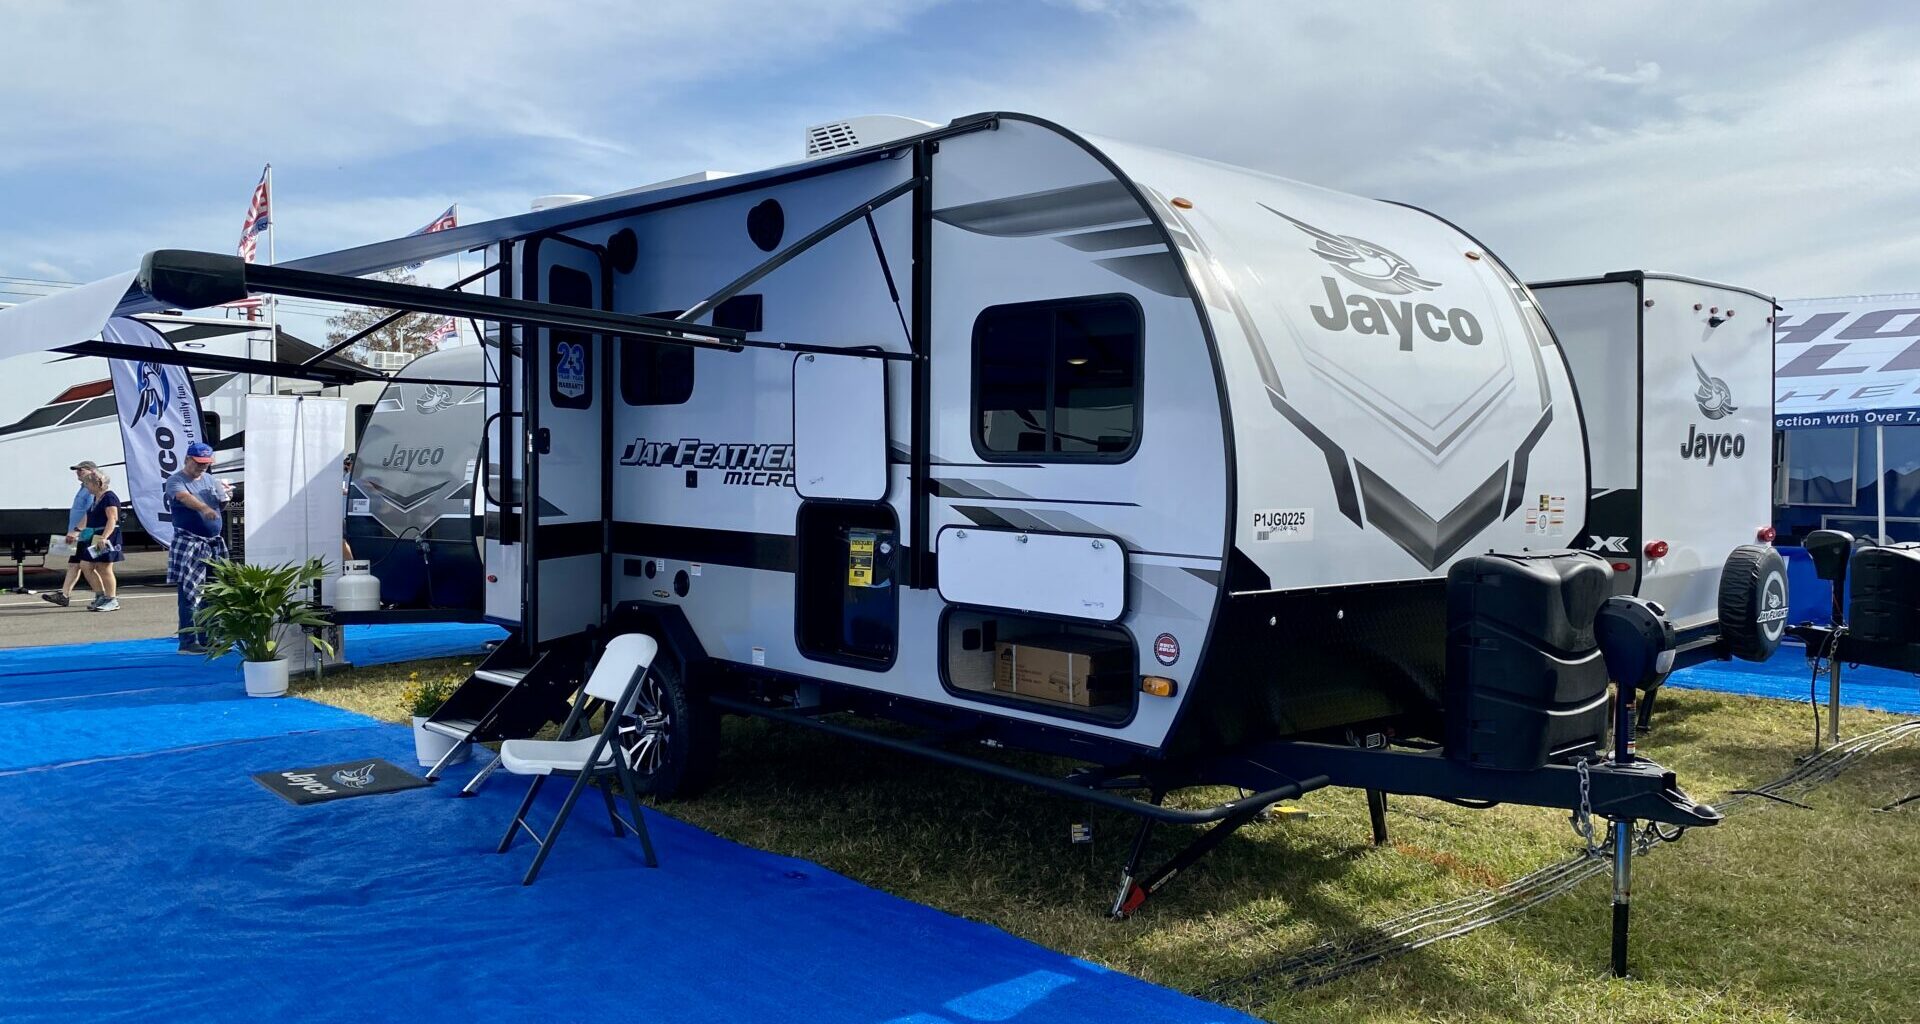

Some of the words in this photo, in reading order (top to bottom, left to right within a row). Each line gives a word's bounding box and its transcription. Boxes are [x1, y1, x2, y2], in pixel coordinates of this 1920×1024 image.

[1310, 276, 1484, 352] Jayco
[178, 384, 187, 400] fun.
[1775, 383, 1920, 402] HE
[180, 401, 192, 427] family
[1826, 412, 1859, 424] With
[1865, 412, 1902, 422] Over
[183, 427, 194, 438] of
[620, 438, 671, 467] JAY
[1680, 424, 1745, 467] Jayco
[382, 443, 445, 473] Jayco
[1253, 512, 1306, 527] P1JG0225
[281, 771, 337, 795] Jayco
